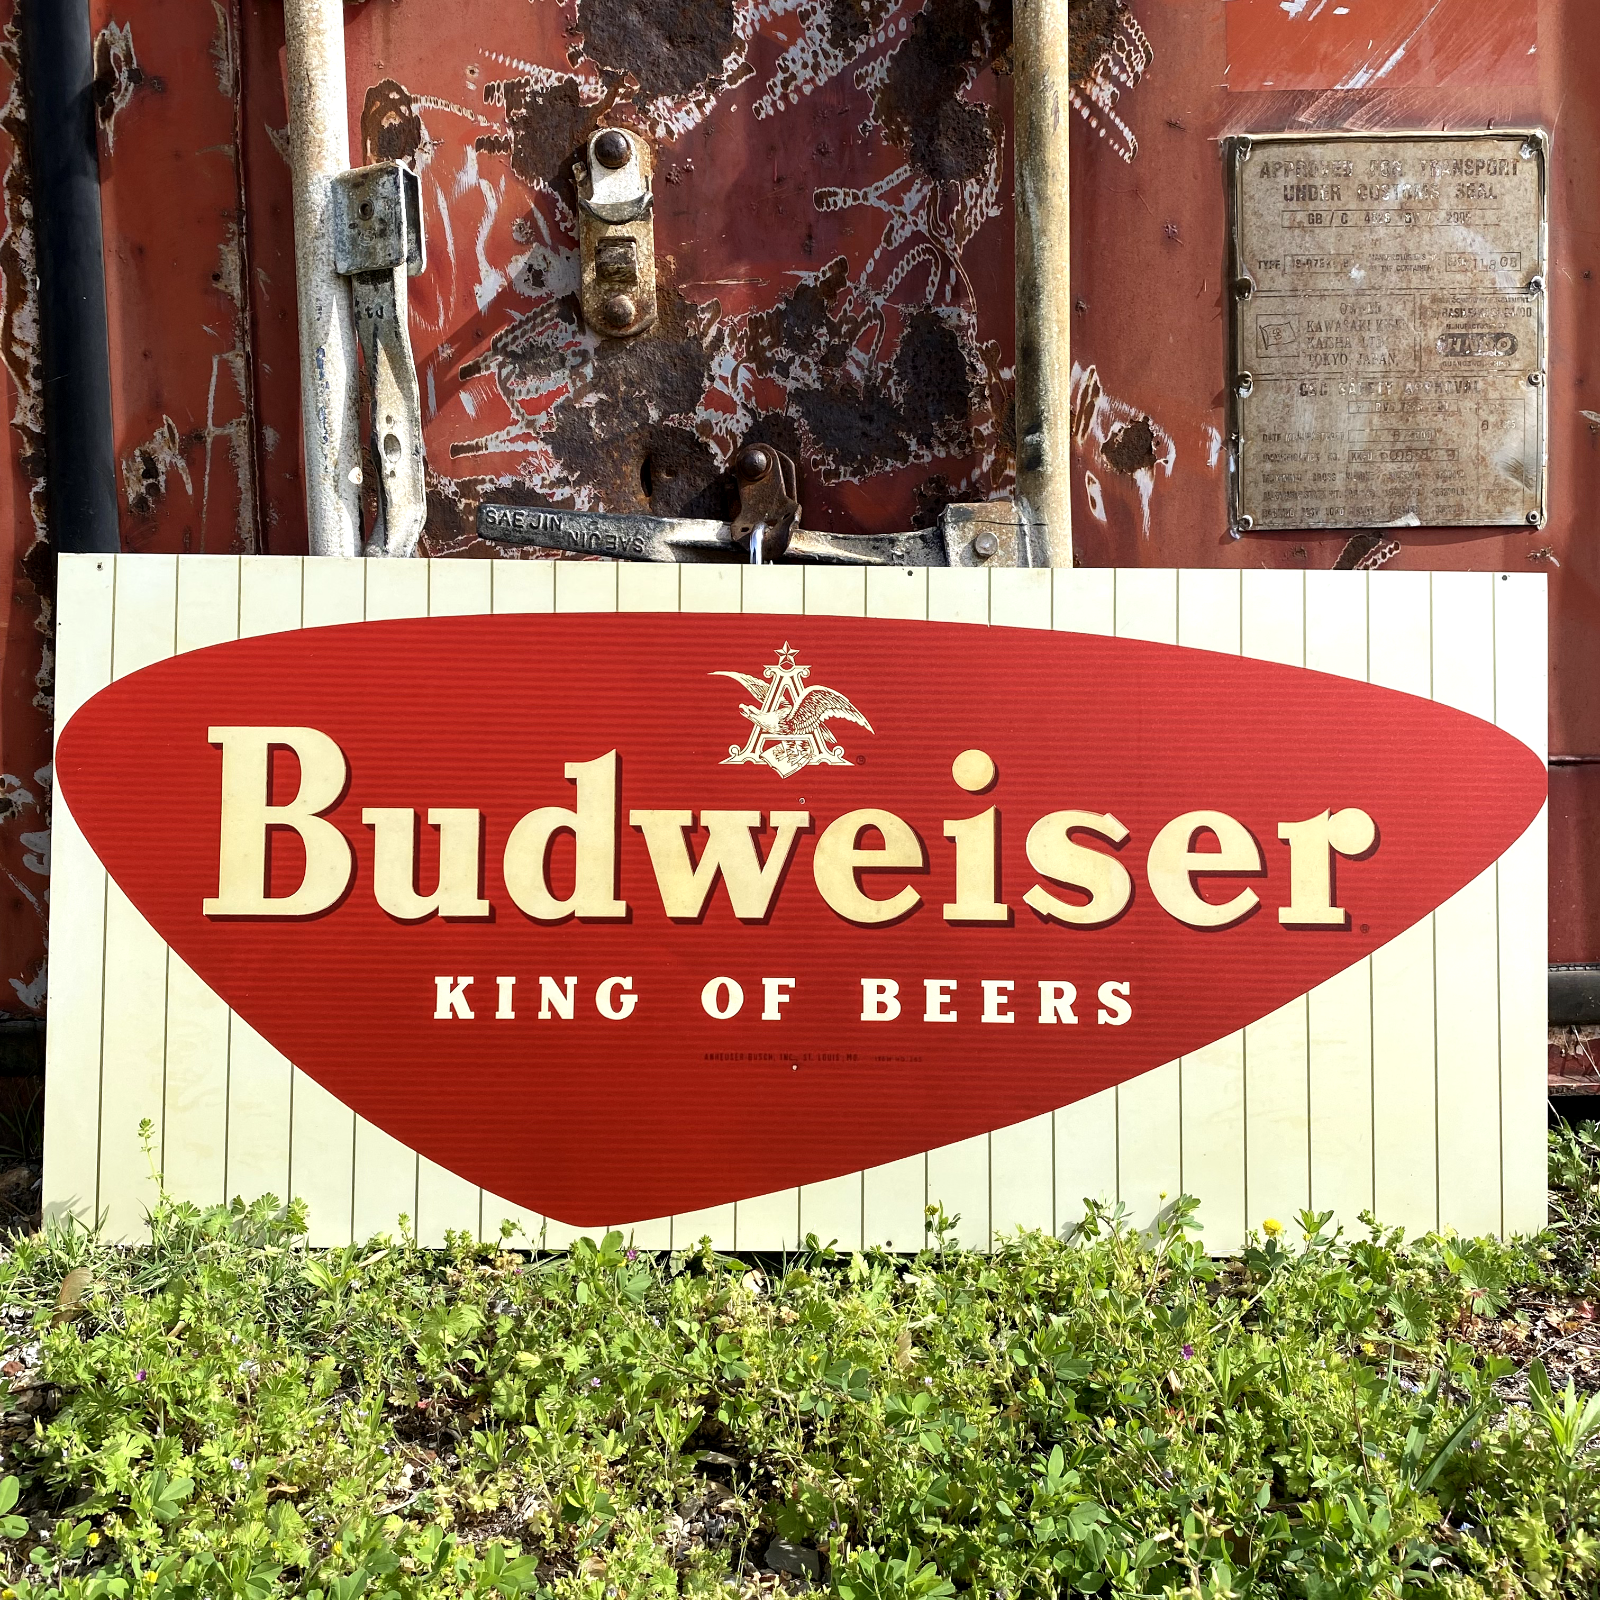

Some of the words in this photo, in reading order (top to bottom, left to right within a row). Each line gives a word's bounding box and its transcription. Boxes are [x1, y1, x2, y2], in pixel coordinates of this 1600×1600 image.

[1259, 159, 1354, 178] APPROVED
[1368, 159, 1403, 178] FOR
[1419, 158, 1520, 178] TRANSPORT
[1283, 184, 1342, 202] UNDER
[1357, 183, 1440, 201] CUSTOMS
[1455, 182, 1498, 200] SEAL
[1257, 259, 1281, 271] TYPE
[1306, 319, 1372, 333] KAWASAKI
[1337, 381, 1394, 397] SAFETY
[1404, 380, 1481, 396] APPROVAL
[485, 508, 525, 529] SAE
[528, 512, 564, 533] JIN
[604, 534, 645, 554] SAE
[203, 726, 1379, 932] Budweiser
[433, 976, 639, 1021] KING
[701, 977, 797, 1021] OF
[861, 978, 1133, 1026] BEERS
